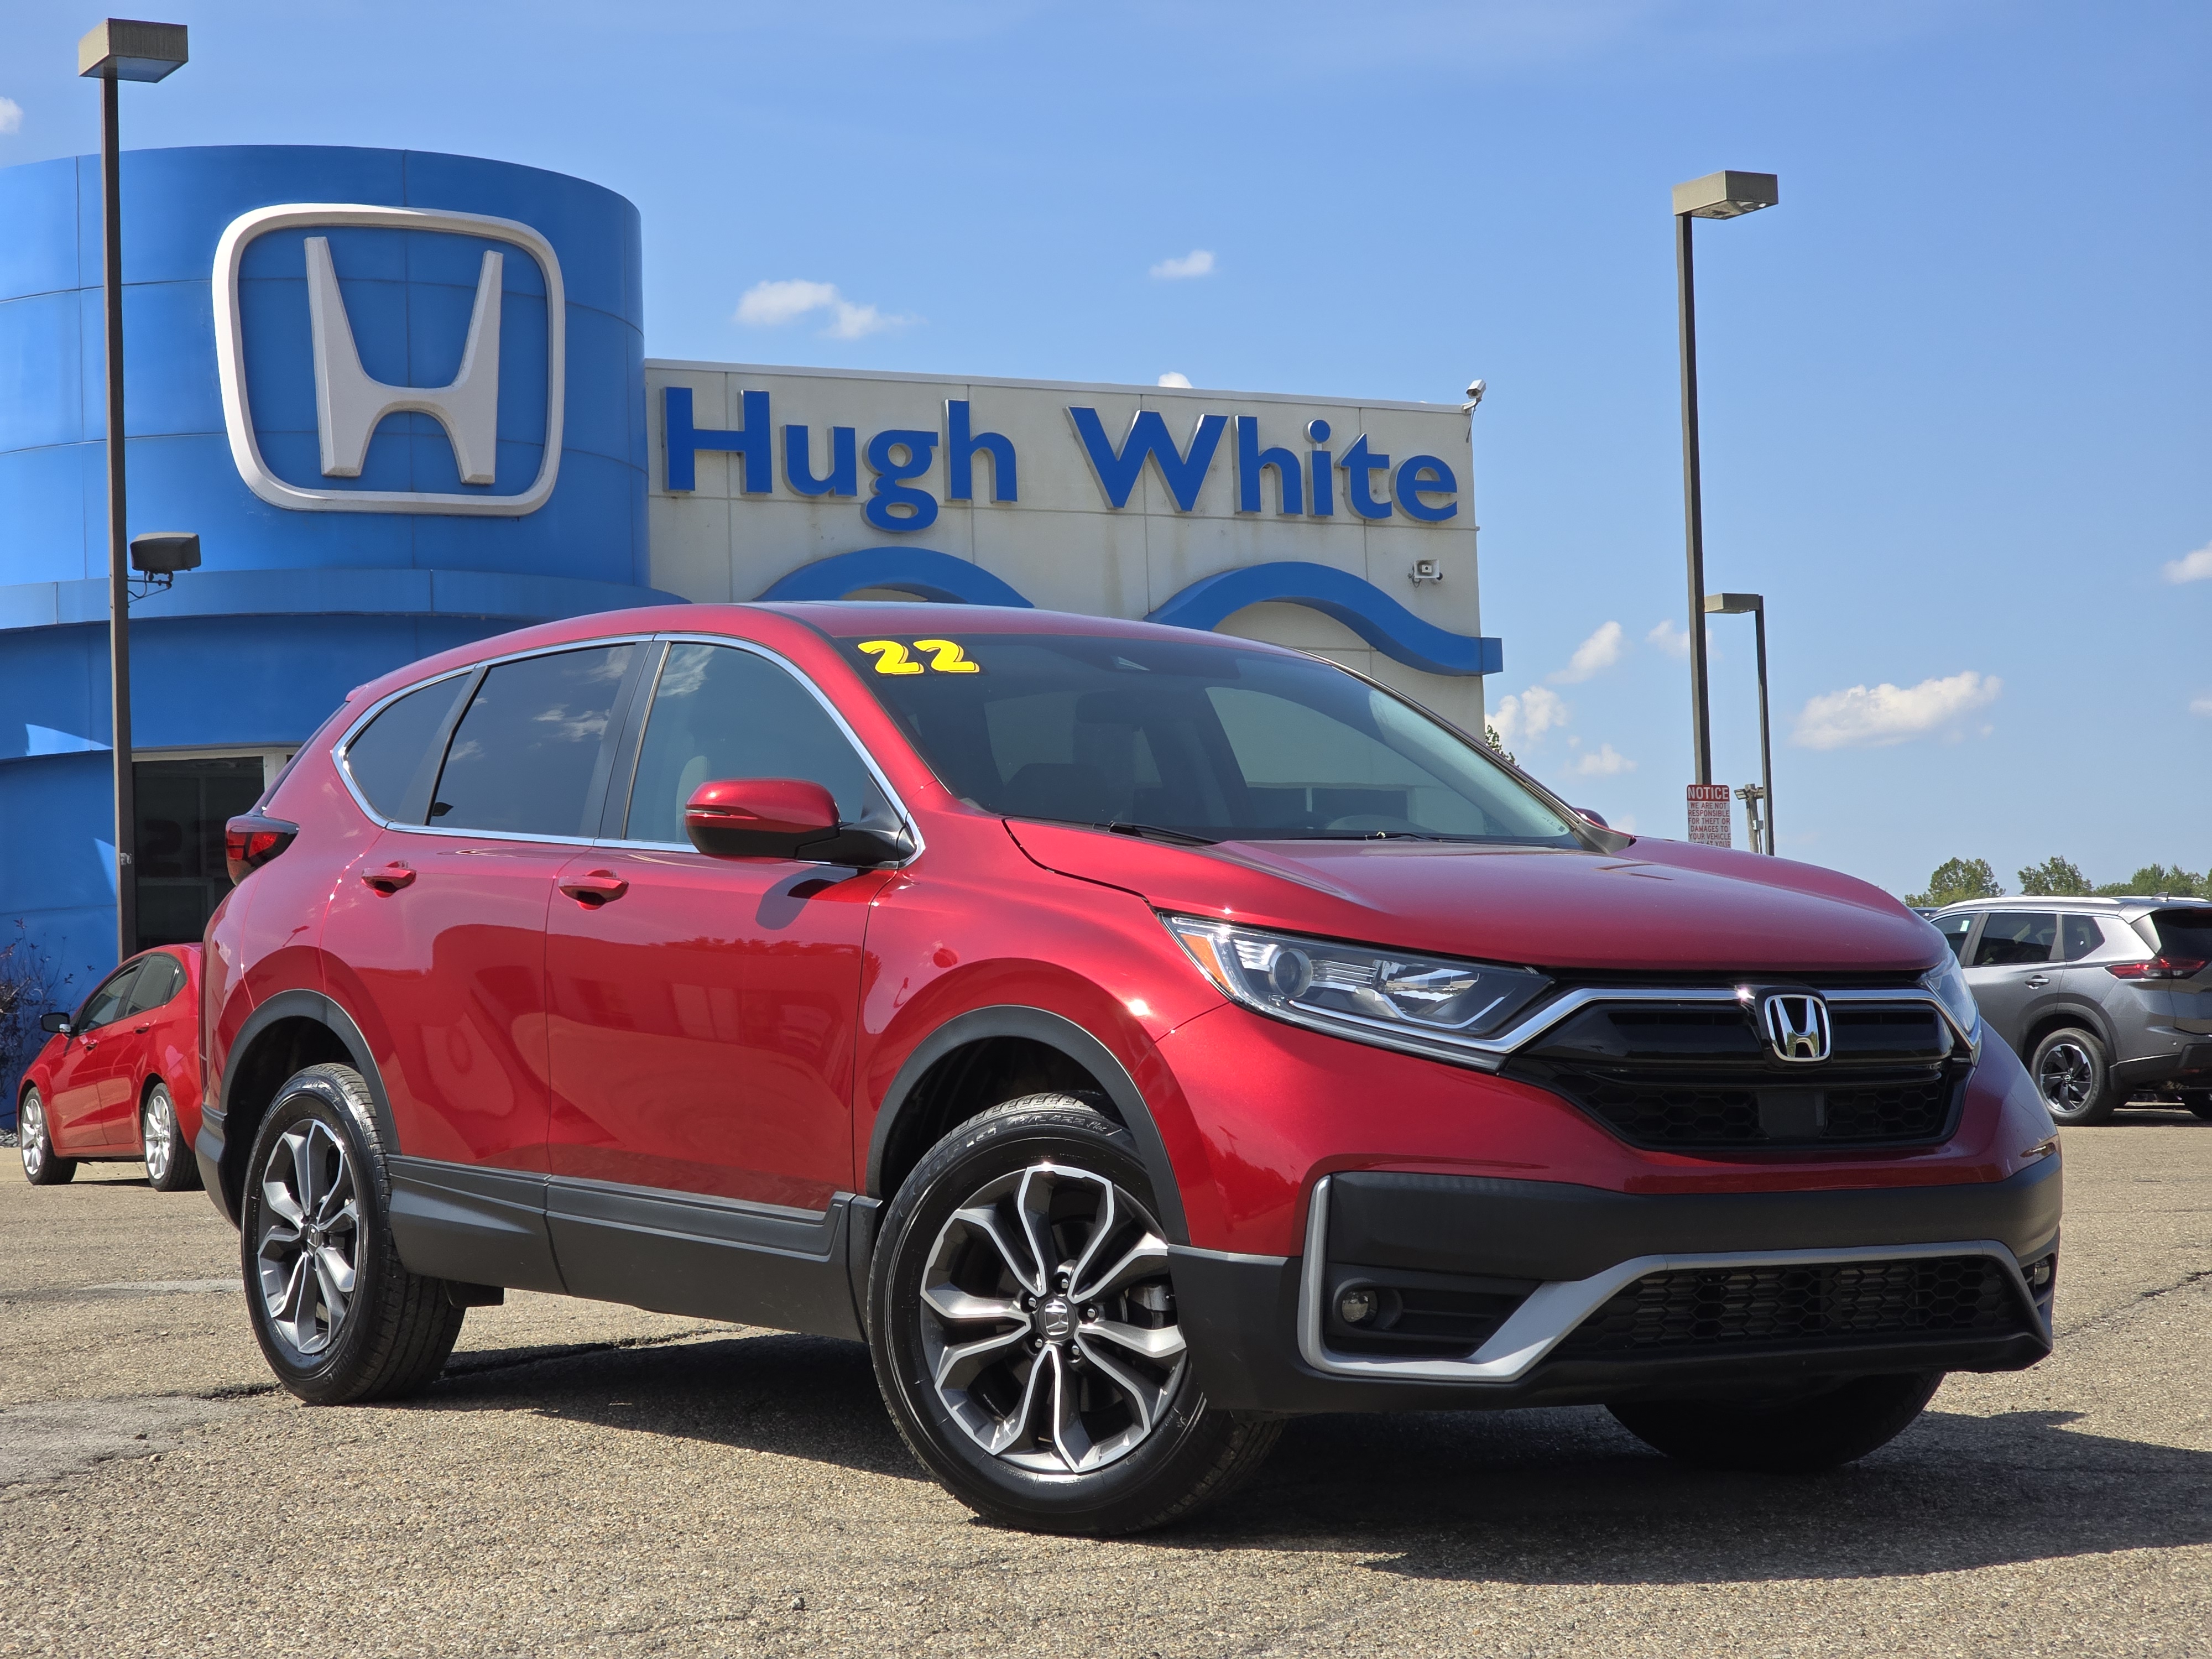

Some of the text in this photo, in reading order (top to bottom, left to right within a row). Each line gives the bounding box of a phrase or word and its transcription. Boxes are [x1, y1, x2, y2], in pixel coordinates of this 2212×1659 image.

[662, 387, 1458, 533] Hugh White
[858, 639, 979, 675] 22
[1688, 786, 1729, 800] NOTICE
